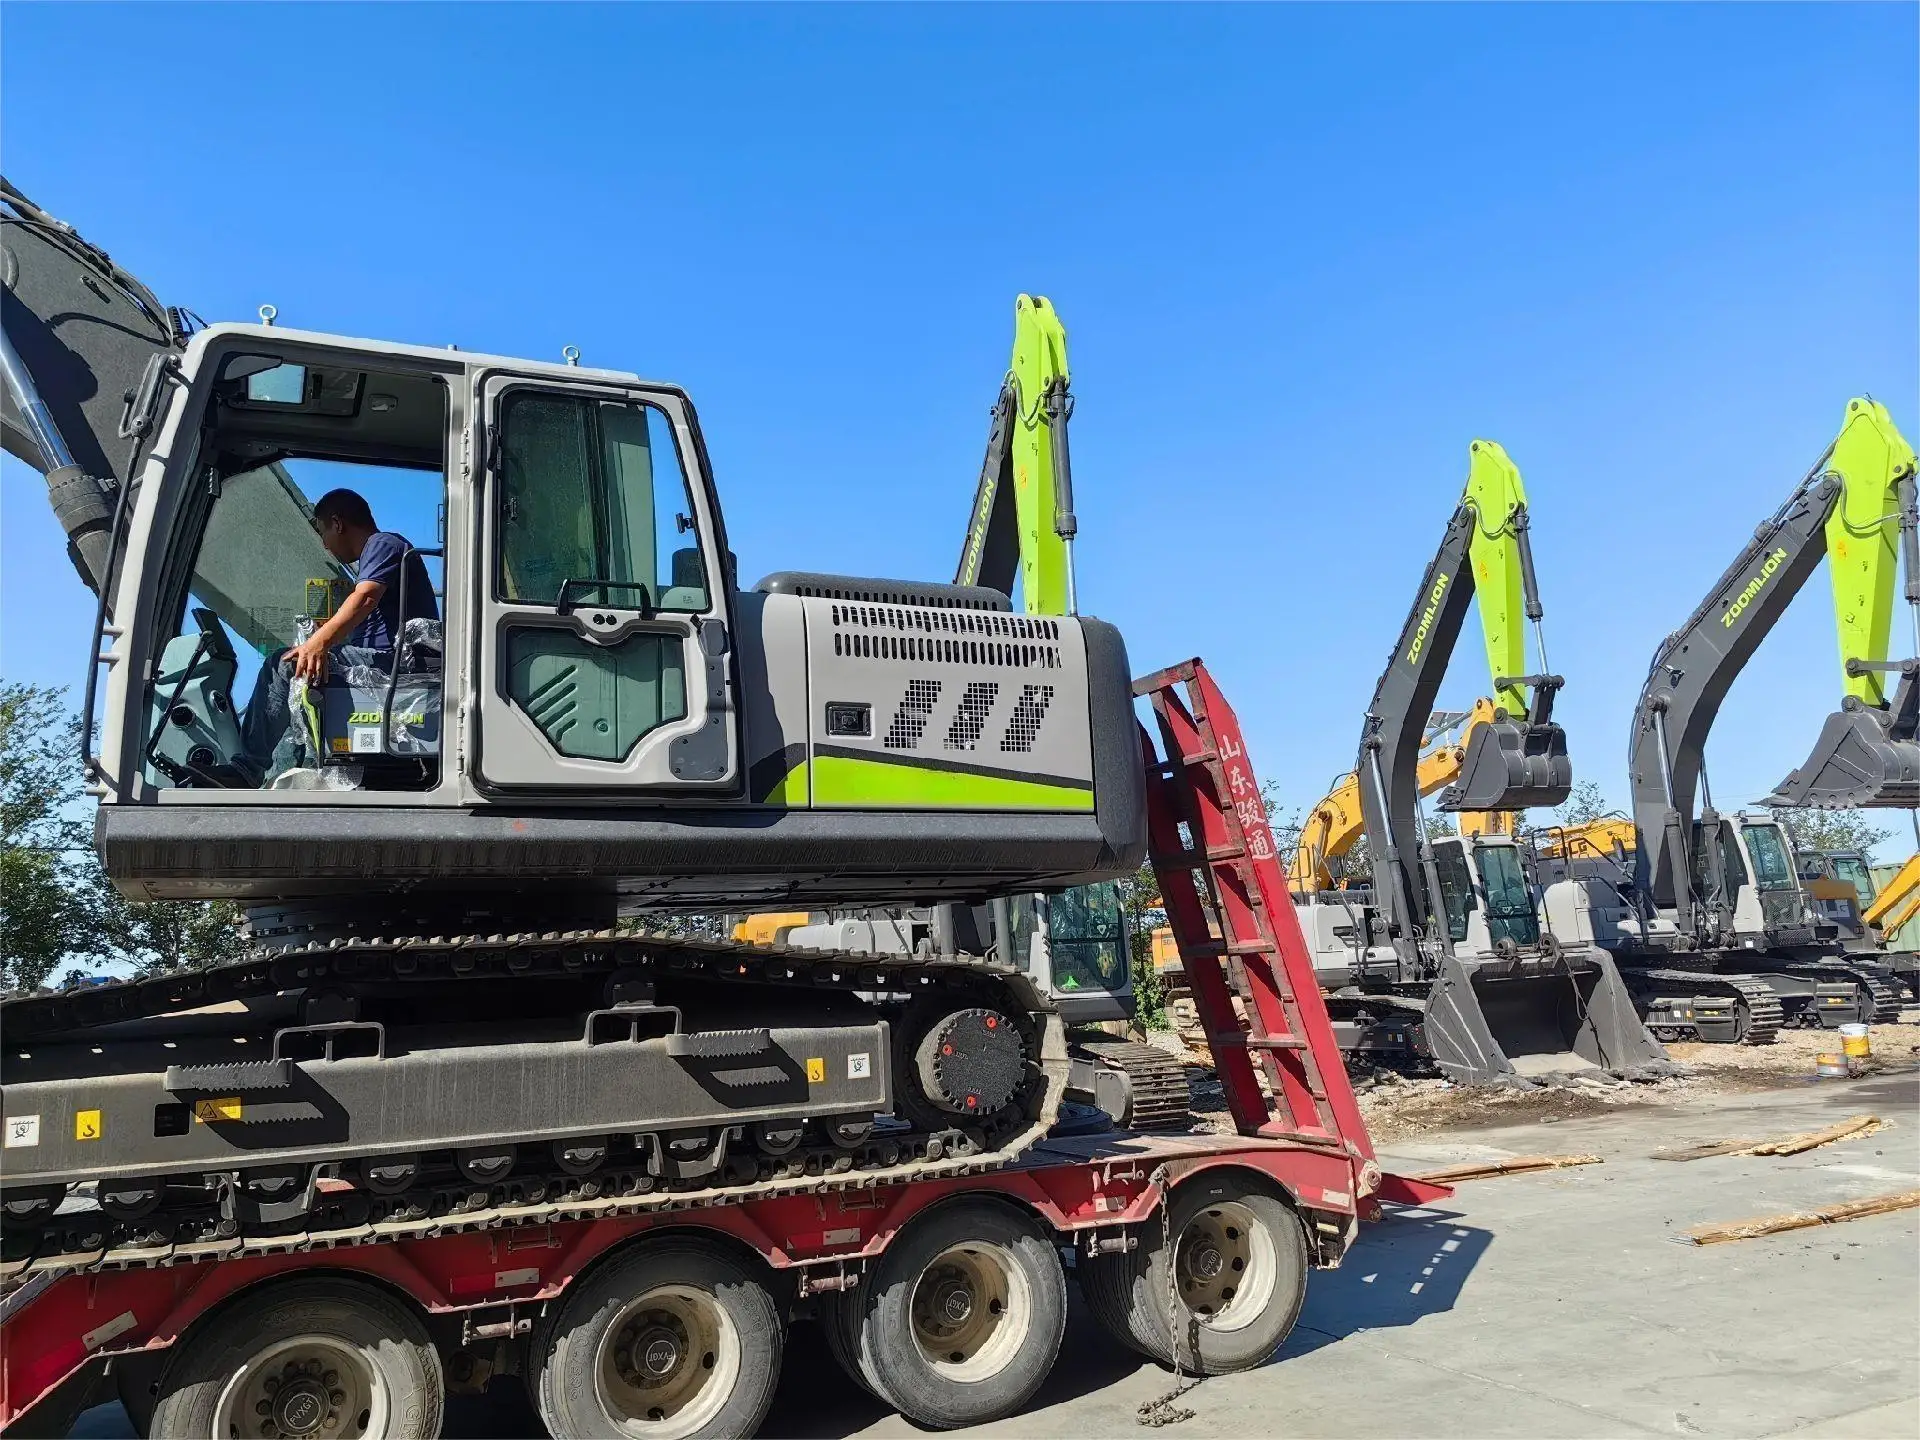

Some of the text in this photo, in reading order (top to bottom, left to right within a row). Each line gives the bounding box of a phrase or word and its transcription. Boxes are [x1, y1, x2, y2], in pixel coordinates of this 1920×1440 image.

[963, 476, 995, 587] OOMLION
[1406, 572, 1449, 665] ZOOMLION
[1721, 547, 1788, 628] ZOOMLION
[1219, 734, 1274, 860] 山东骏通
[289, 1397, 316, 1426] FVXGT
